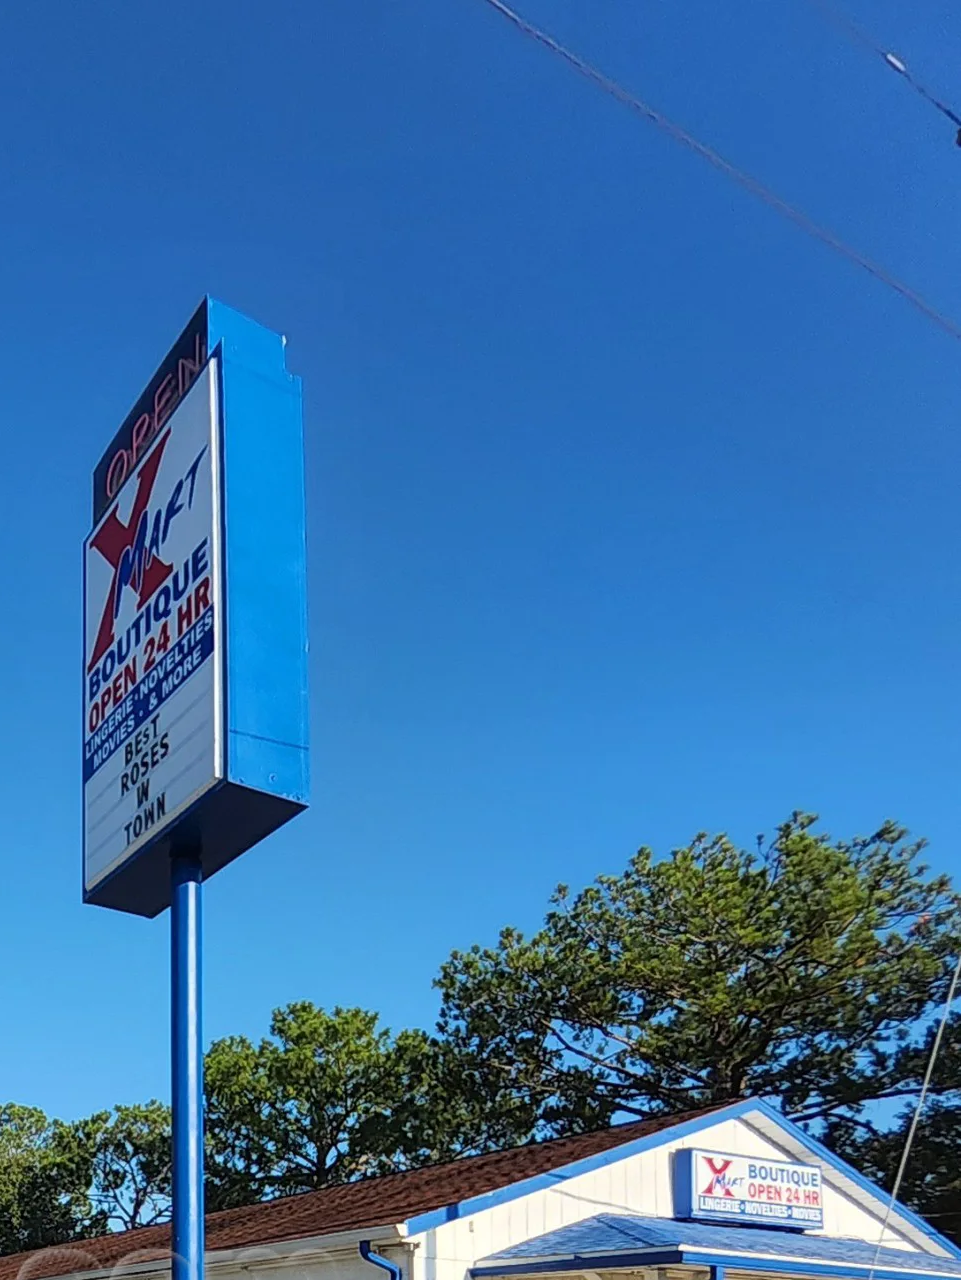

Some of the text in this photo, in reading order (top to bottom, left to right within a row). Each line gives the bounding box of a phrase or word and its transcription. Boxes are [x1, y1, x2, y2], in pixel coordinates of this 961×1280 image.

[106, 333, 206, 499] OPEN
[89, 537, 209, 702] BOUTIQUE
[86, 610, 213, 760] LINGERIE NOVELTIES
[90, 576, 210, 733] OPEN 24 HR
[93, 644, 202, 770] MOVIES & MORE
[121, 732, 169, 797] ROSES
[125, 713, 160, 767] BEST
[124, 792, 166, 846] TOWN
[136, 778, 150, 809] IN
[748, 1164, 820, 1188] BOUTIQUE
[748, 1182, 820, 1206] OPEN 24 HR
